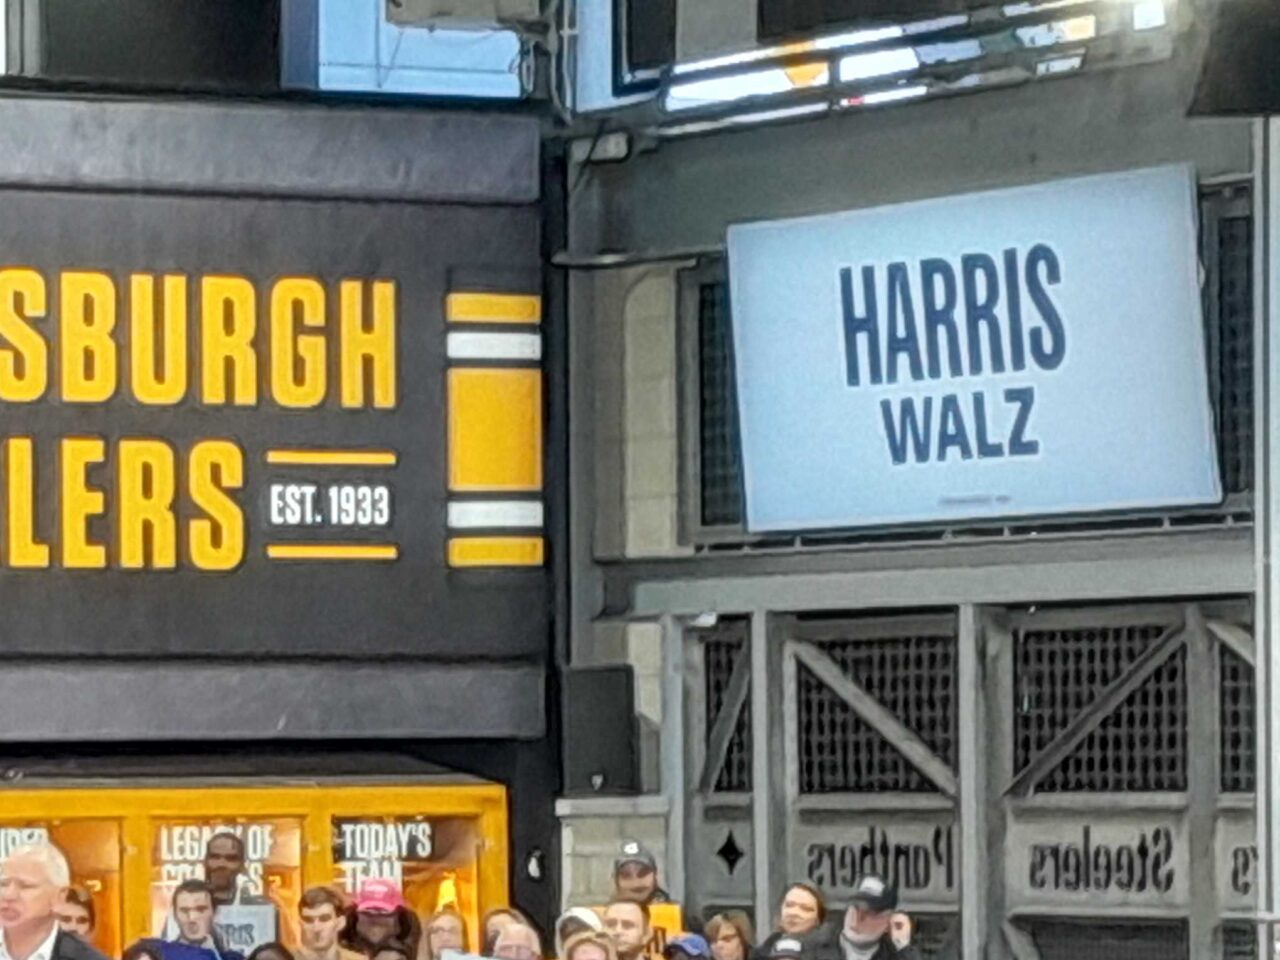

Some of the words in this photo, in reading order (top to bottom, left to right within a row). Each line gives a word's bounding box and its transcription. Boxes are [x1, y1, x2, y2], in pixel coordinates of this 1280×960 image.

[839, 243, 1066, 387] HARRIS
[880, 386, 1039, 465] WALZ
[271, 484, 320, 525] EST.
[328, 484, 391, 526] 1933
[247, 825, 273, 860] OF
[342, 822, 431, 858] TODAY'S
